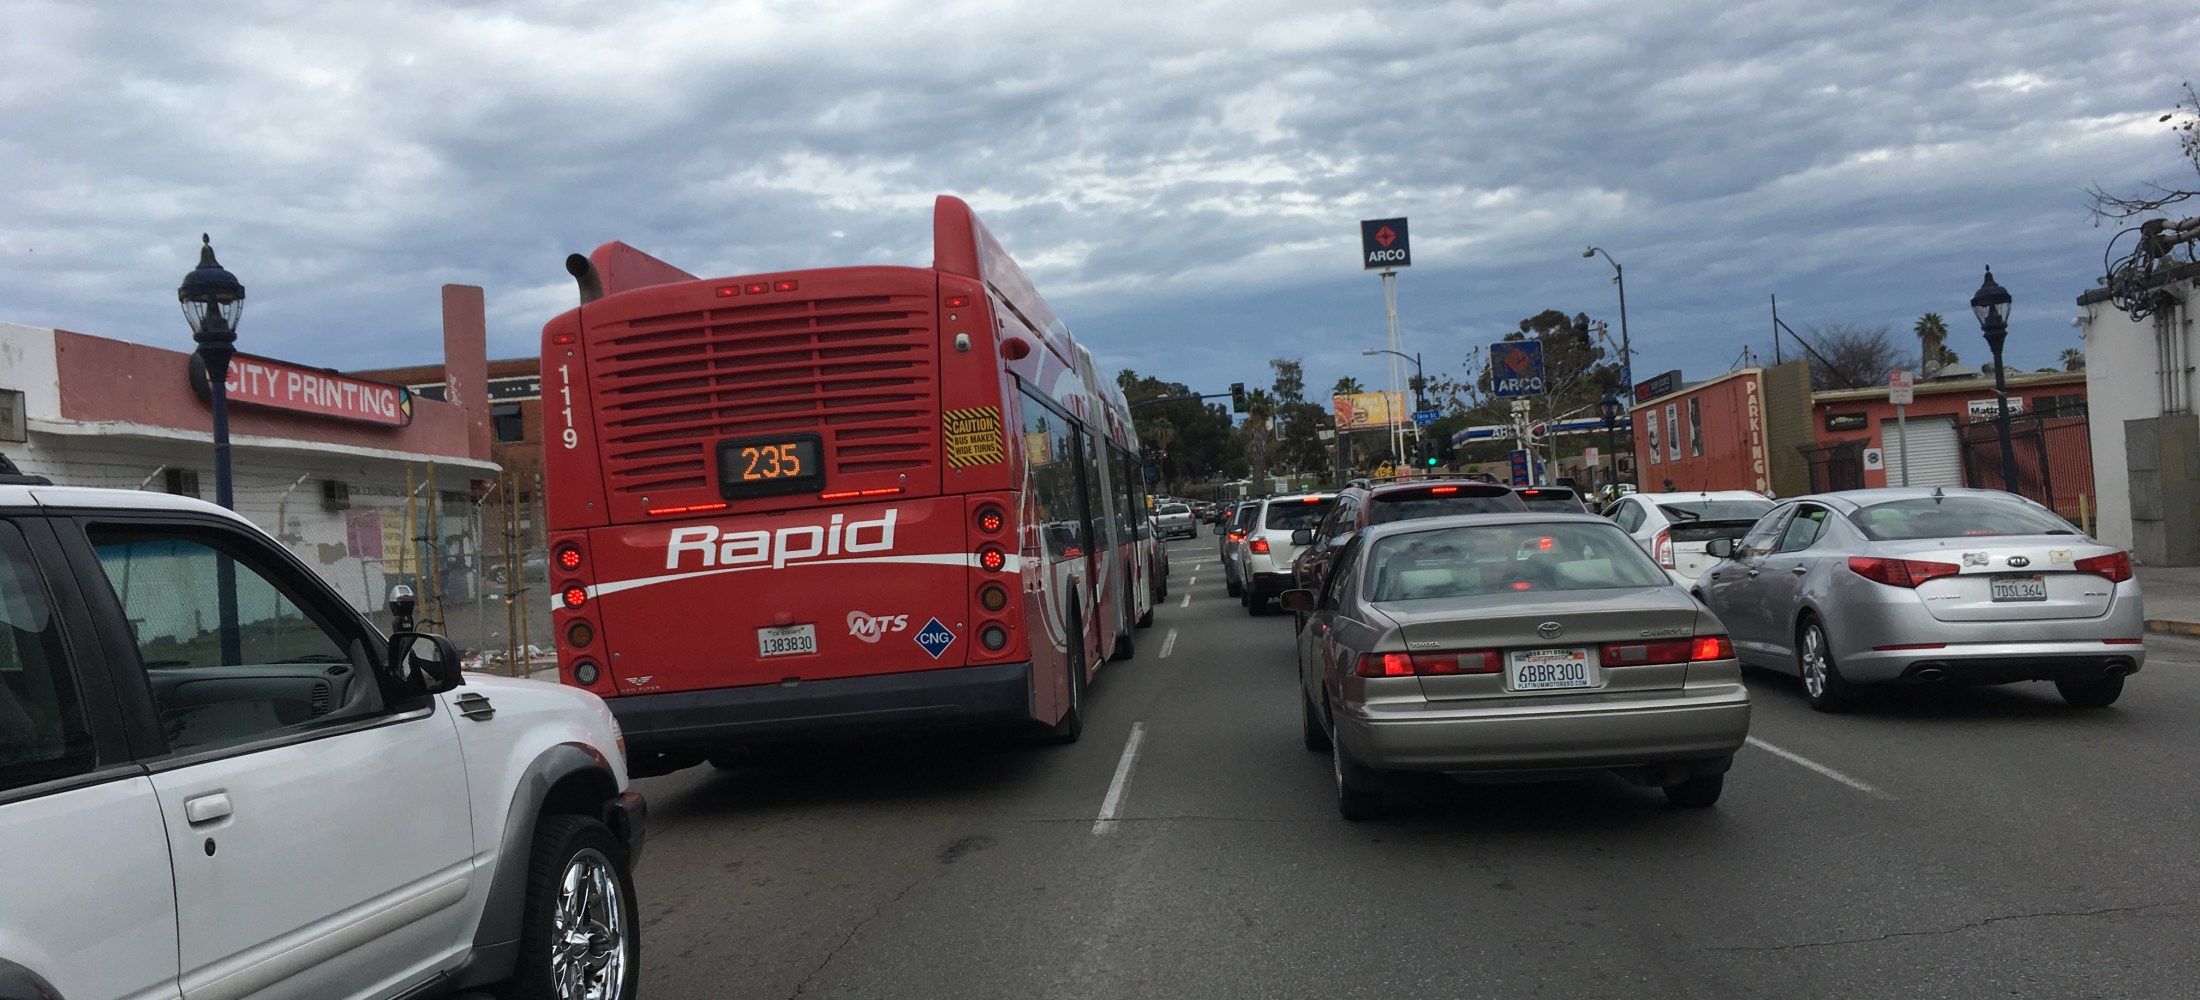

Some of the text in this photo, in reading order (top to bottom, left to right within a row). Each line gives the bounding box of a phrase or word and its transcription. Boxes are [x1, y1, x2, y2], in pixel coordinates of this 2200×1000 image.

[1369, 249, 1405, 262] ARCO
[224, 360, 395, 418] CITY PRINTING
[1498, 377, 1542, 392] ARCO
[558, 364, 578, 449] 1119
[952, 417, 994, 433] CAUTION
[1746, 381, 1764, 474] PARKING
[954, 433, 995, 445] BUS MAKES
[955, 443, 996, 455] WIDE TURNS
[741, 443, 800, 480] 235
[666, 508, 898, 569] Rapid
[1994, 584, 2042, 597] 7DSL364
[849, 614, 910, 635] MTS
[763, 635, 812, 653] 1383830
[919, 632, 950, 645] CNG
[1519, 662, 1584, 682] 6BBR300
